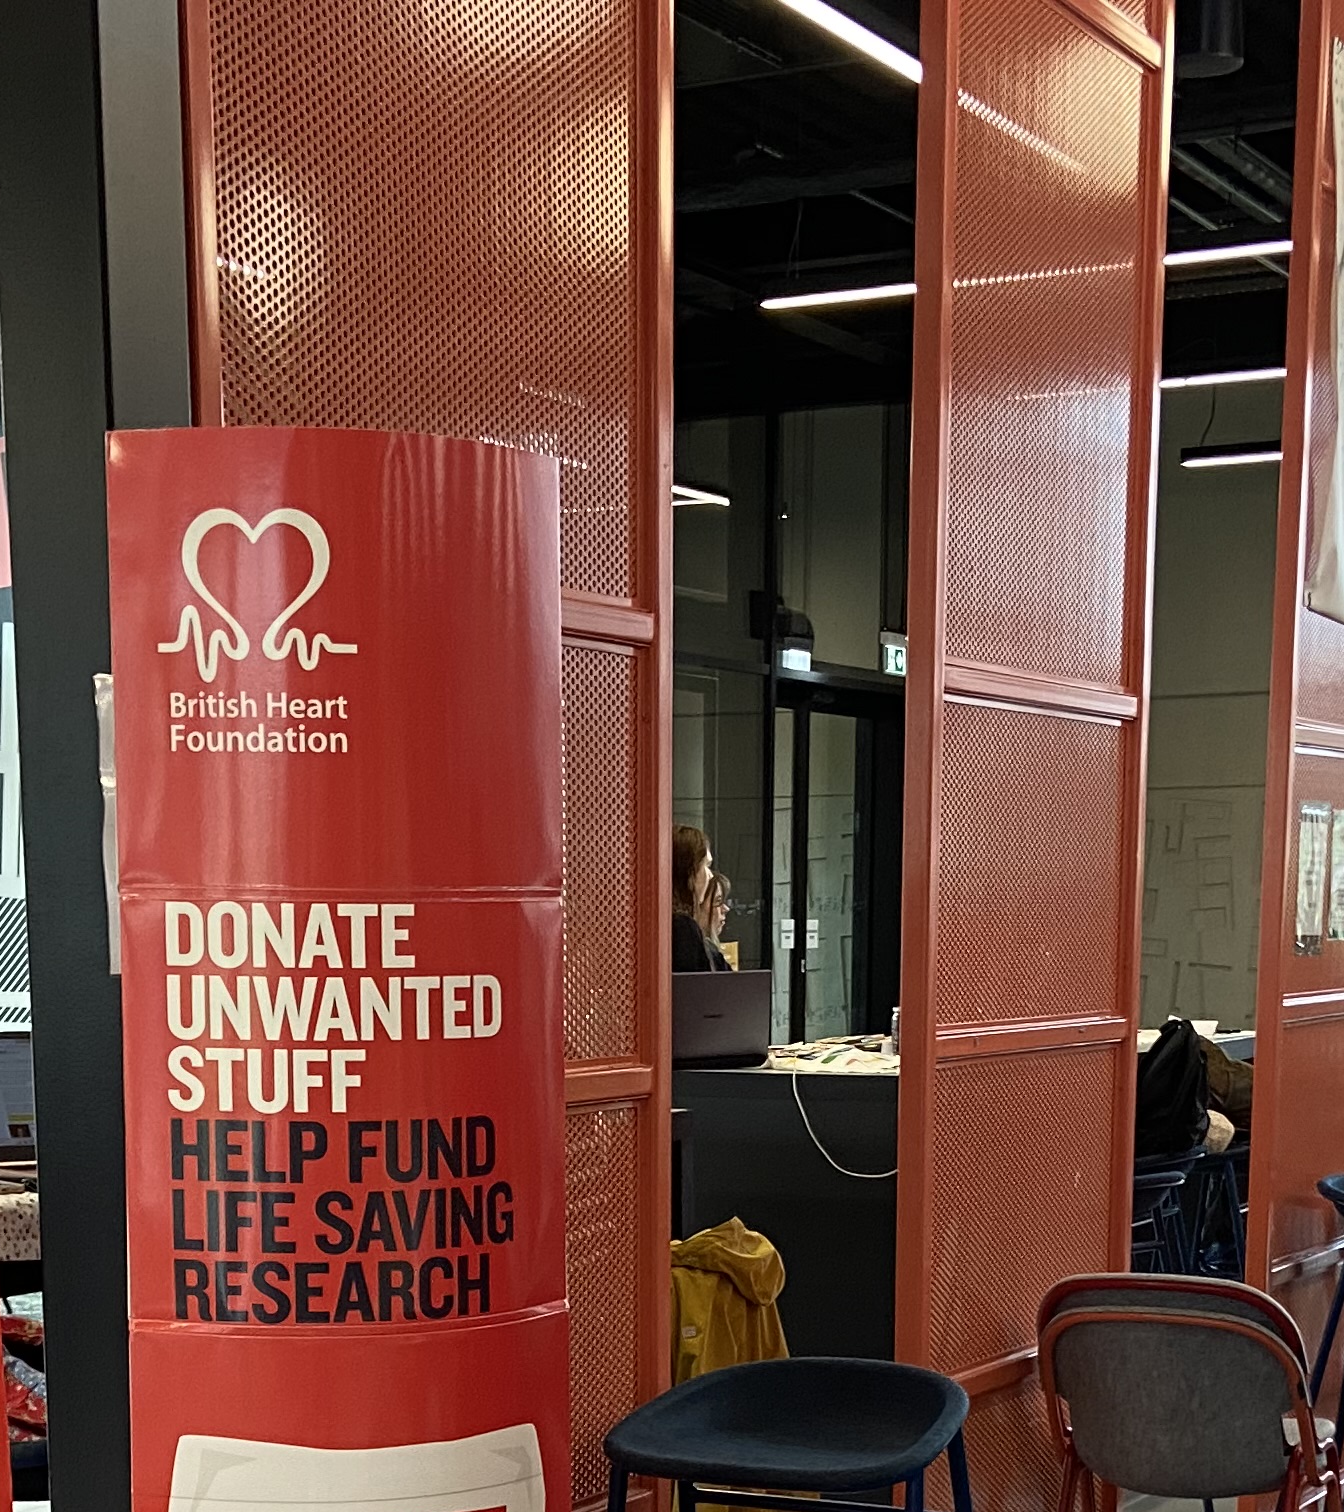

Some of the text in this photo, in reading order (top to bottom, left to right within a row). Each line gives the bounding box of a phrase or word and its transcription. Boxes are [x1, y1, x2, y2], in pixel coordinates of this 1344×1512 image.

[169, 691, 349, 721] British Heart
[169, 724, 349, 754] Foundation
[165, 901, 416, 969] DONATE
[166, 975, 503, 1041] UNWANTED
[167, 1045, 367, 1114] STUFF
[171, 1116, 497, 1183] HELP FUND
[171, 1182, 515, 1256] LIFE SAVING
[175, 1252, 492, 1326] RESEARCH
